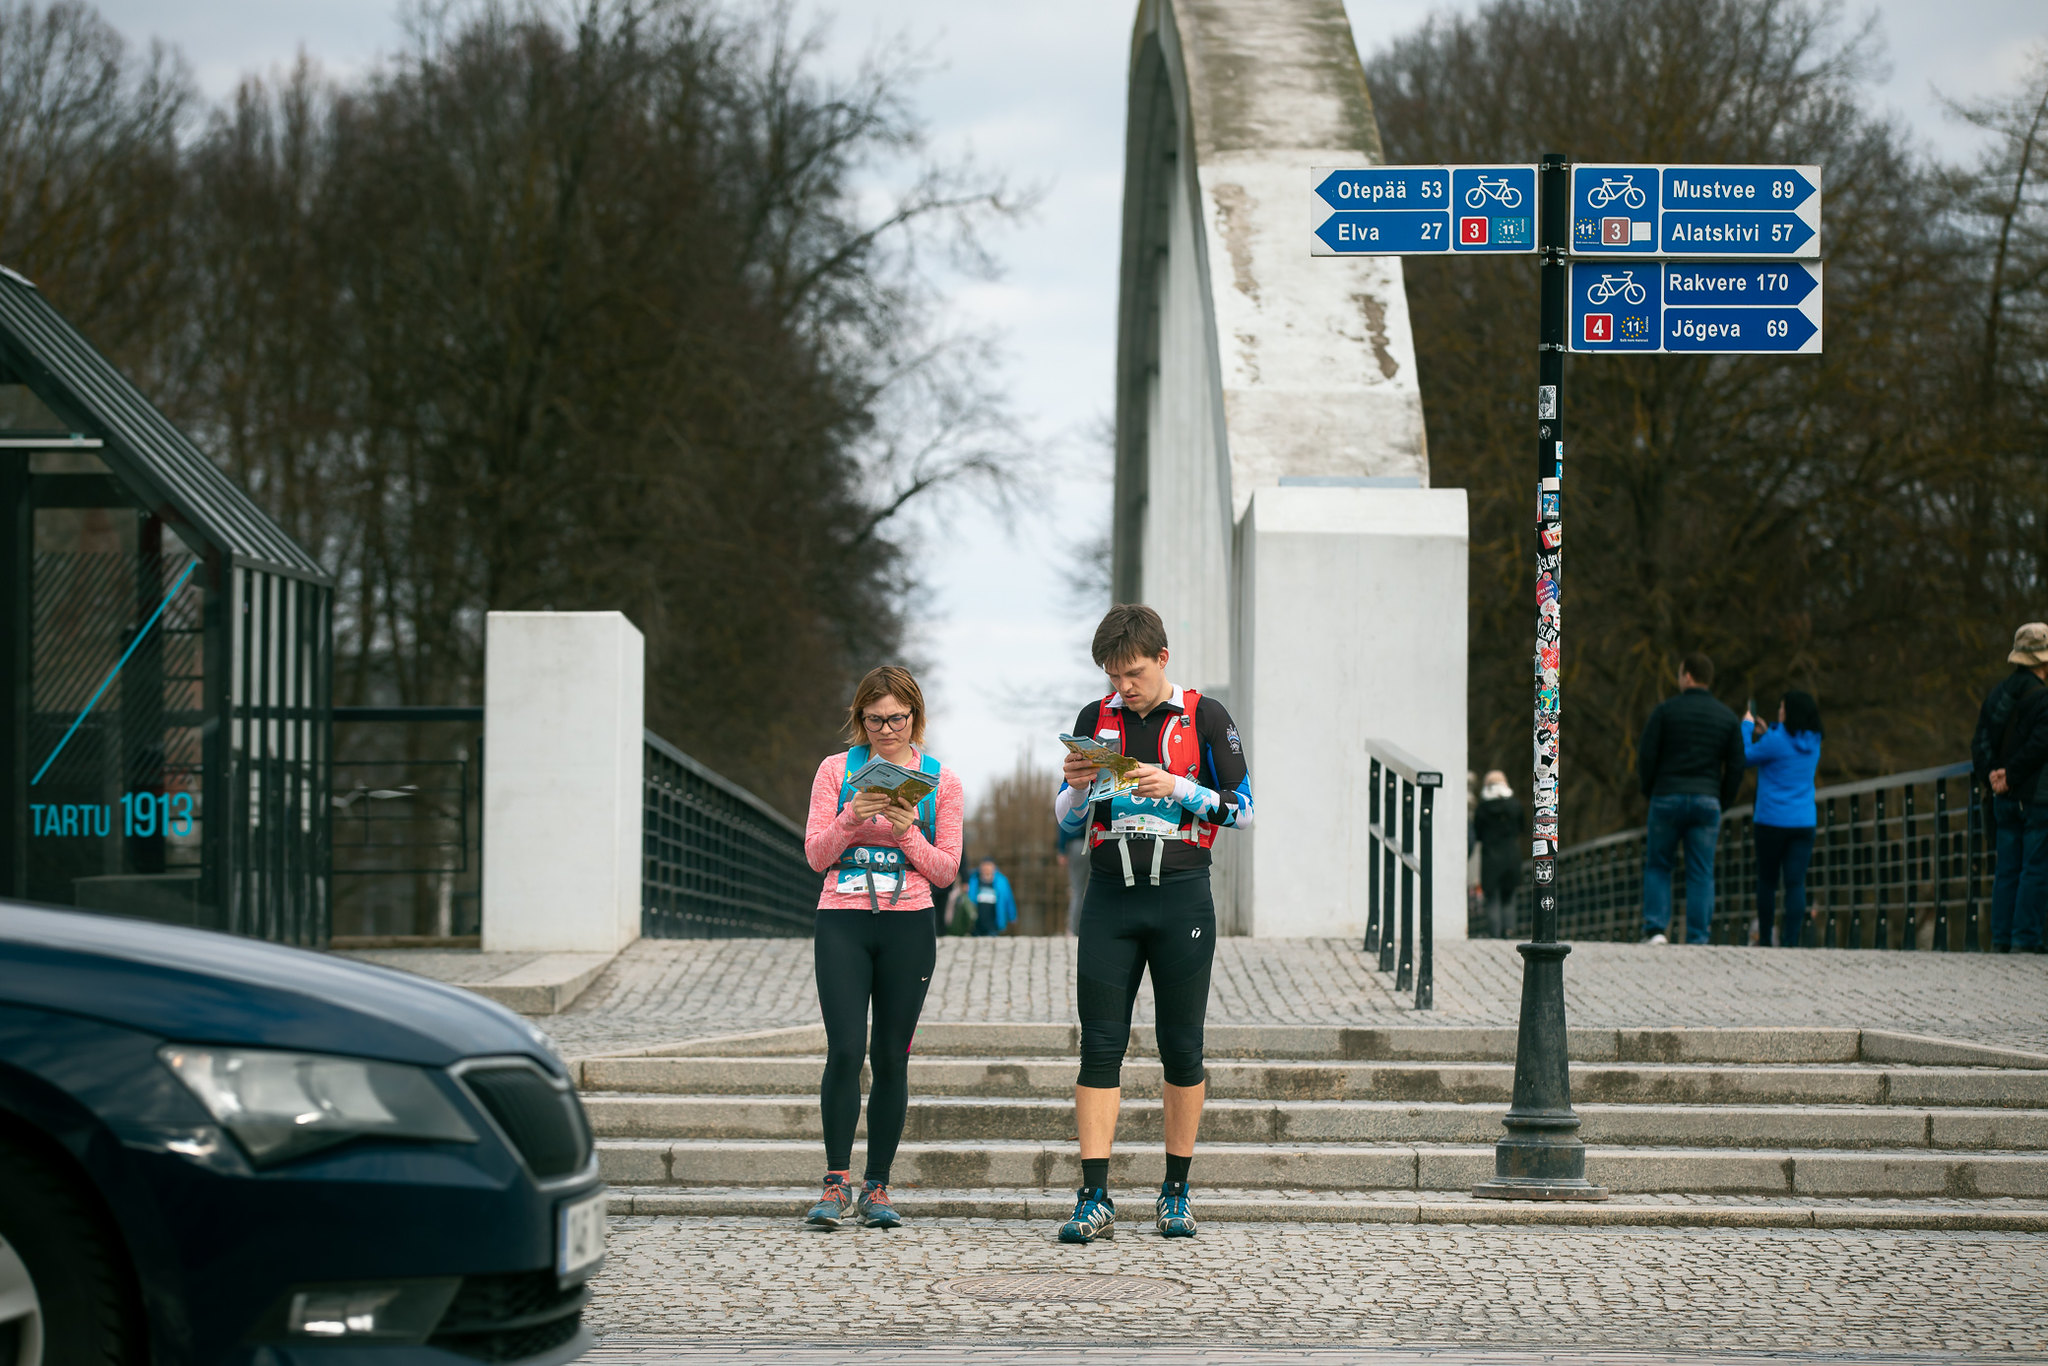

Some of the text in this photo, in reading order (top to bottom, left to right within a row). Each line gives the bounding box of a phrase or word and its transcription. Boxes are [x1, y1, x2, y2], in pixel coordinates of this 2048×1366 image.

[1338, 181, 1442, 202] Otepää 53
[1673, 180, 1795, 199] Mustvee 89
[1338, 222, 1443, 241] Elva 27
[1469, 223, 1480, 239] 3
[1502, 224, 1514, 235] 11
[1578, 223, 1592, 235] 11
[1610, 223, 1621, 240] 3
[1671, 223, 1793, 242] Alatskivi 57
[1669, 273, 1789, 291] Rakvere 170
[1592, 319, 1604, 336] 4
[1627, 321, 1639, 332] 11
[1672, 319, 1788, 342] Jõgeva 69
[31, 791, 194, 837] TARTU 1913
